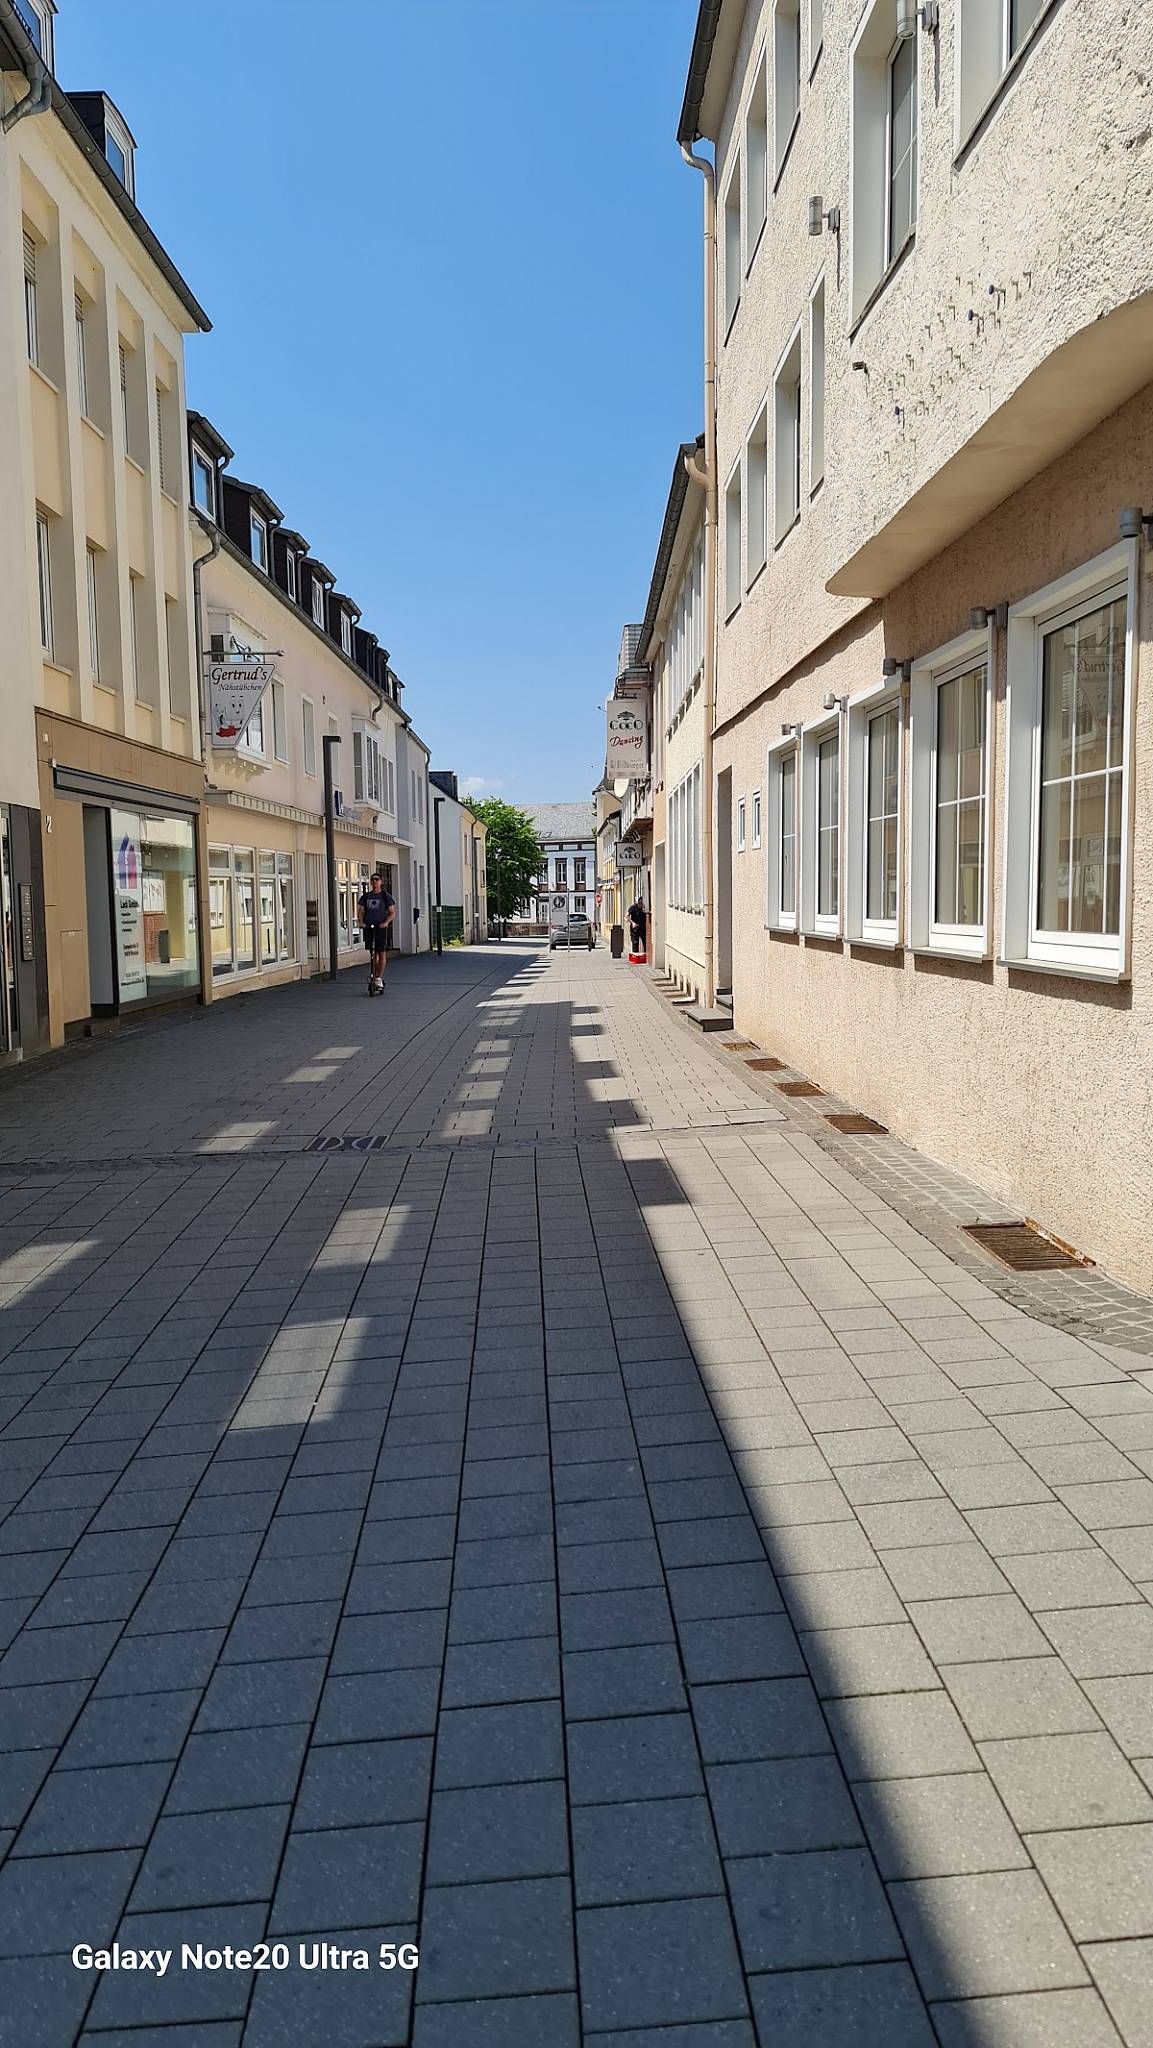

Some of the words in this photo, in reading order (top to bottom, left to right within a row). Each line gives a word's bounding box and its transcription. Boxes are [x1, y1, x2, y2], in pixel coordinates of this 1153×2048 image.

[211, 666, 268, 685] Gertrud's
[609, 735, 644, 750] Dancing
[46, 815, 53, 834] 2
